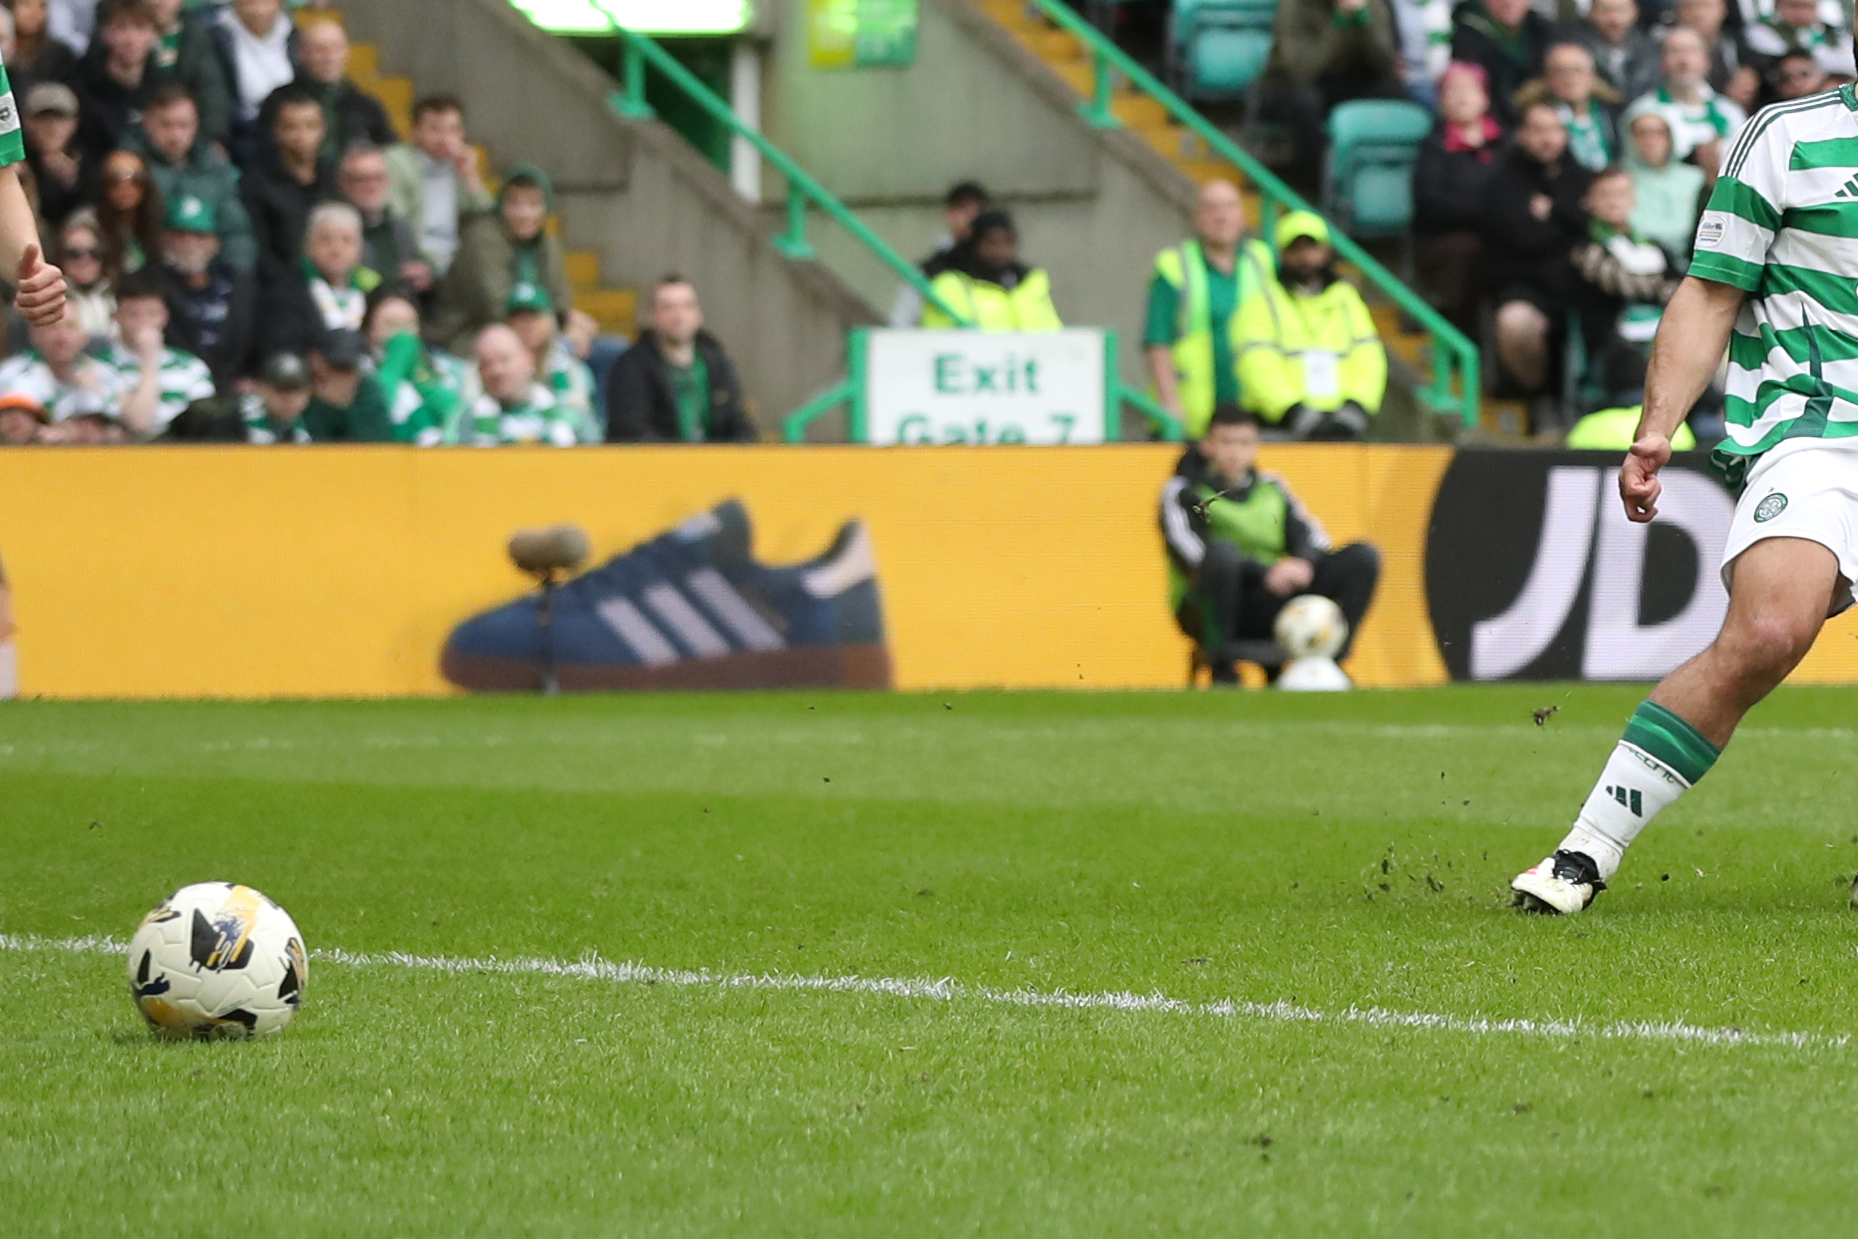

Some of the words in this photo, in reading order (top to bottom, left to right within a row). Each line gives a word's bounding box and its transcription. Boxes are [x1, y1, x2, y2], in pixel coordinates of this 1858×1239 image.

[933, 353, 1041, 394] Exit
[1051, 414, 1078, 444] 7
[1468, 464, 1736, 682] JD
